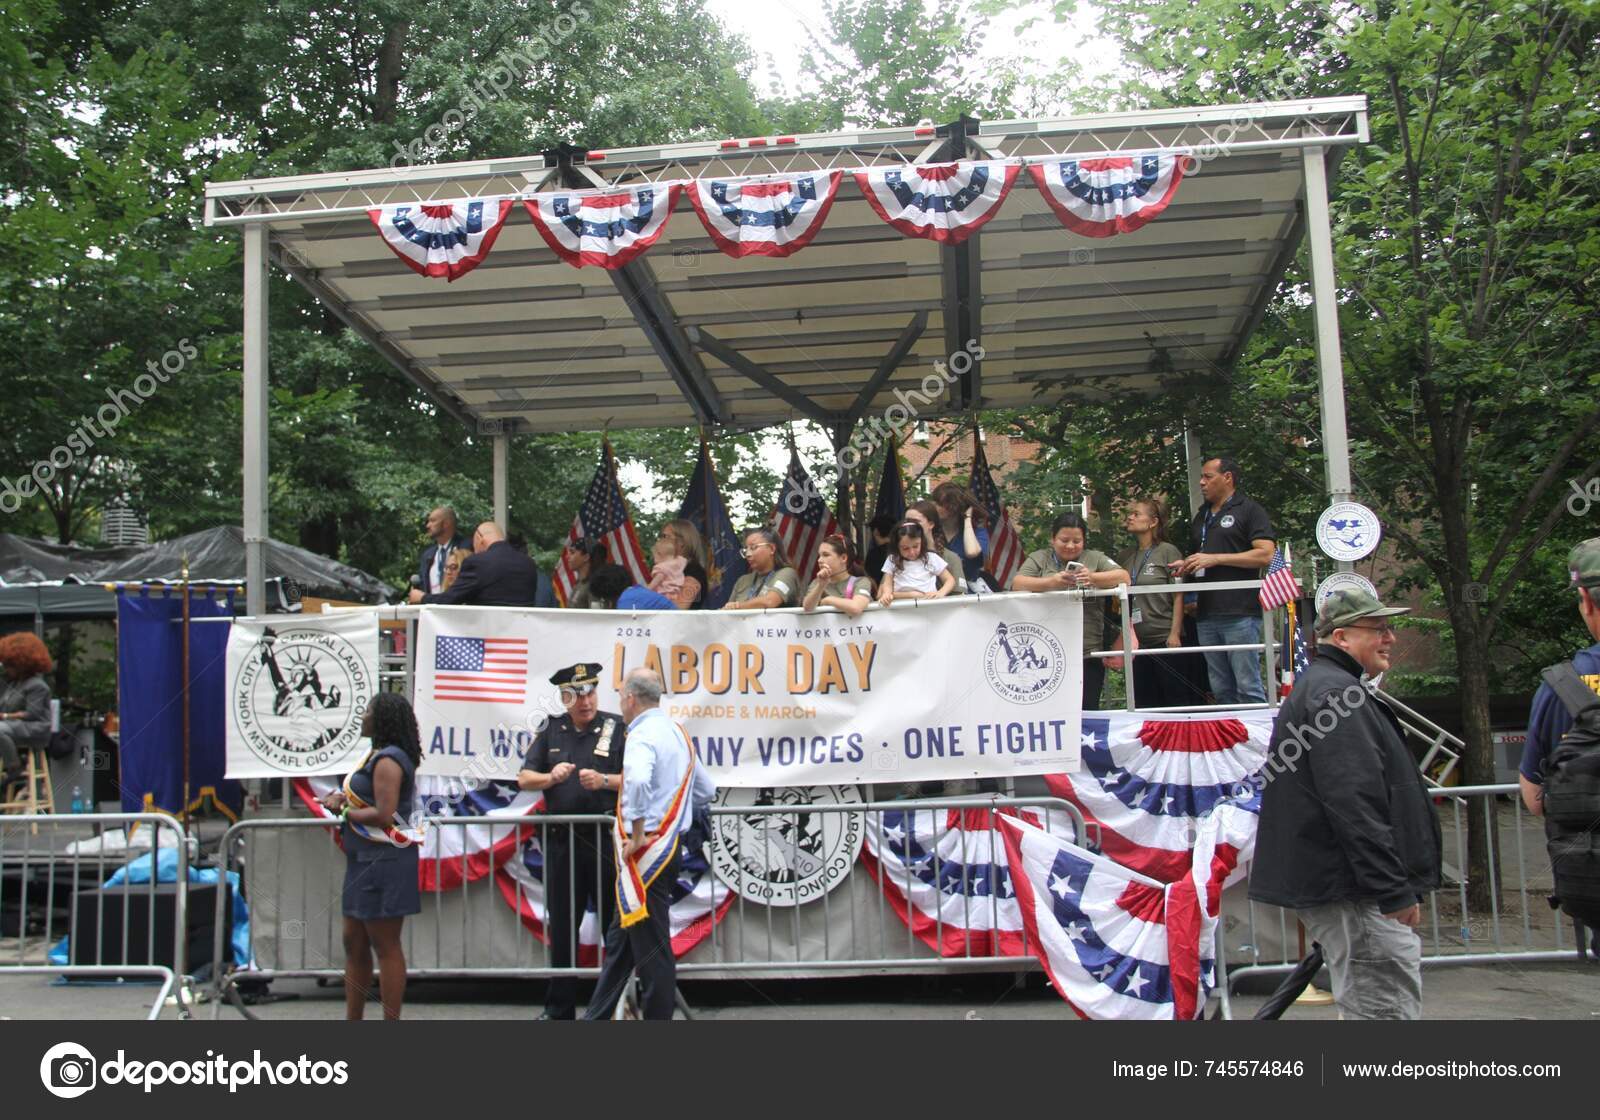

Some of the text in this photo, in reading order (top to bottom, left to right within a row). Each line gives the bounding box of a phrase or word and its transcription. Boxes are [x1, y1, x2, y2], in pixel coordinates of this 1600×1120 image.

[617, 625, 874, 639] 2024 NEW YORK CITY
[1010, 626, 1044, 637] CENTRAL
[1044, 634, 1062, 659] LABOR
[611, 640, 877, 695] LABOR DAY
[1047, 661, 1063, 692] COUNCIL
[239, 632, 367, 758] NEW YORK CITY CENTRAL LABOR COUNCIL
[993, 681, 1009, 696] NEW
[1012, 692, 1042, 702] AFL CIO
[670, 705, 817, 720] PARADE & MARCH
[429, 725, 476, 757] ALL
[757, 733, 864, 767] VOICES
[904, 726, 965, 760] ONE
[977, 719, 1066, 756] FIGHT
[278, 751, 329, 767] AFL CIO
[784, 857, 847, 900] COUNCL
[747, 881, 774, 899] CIO
